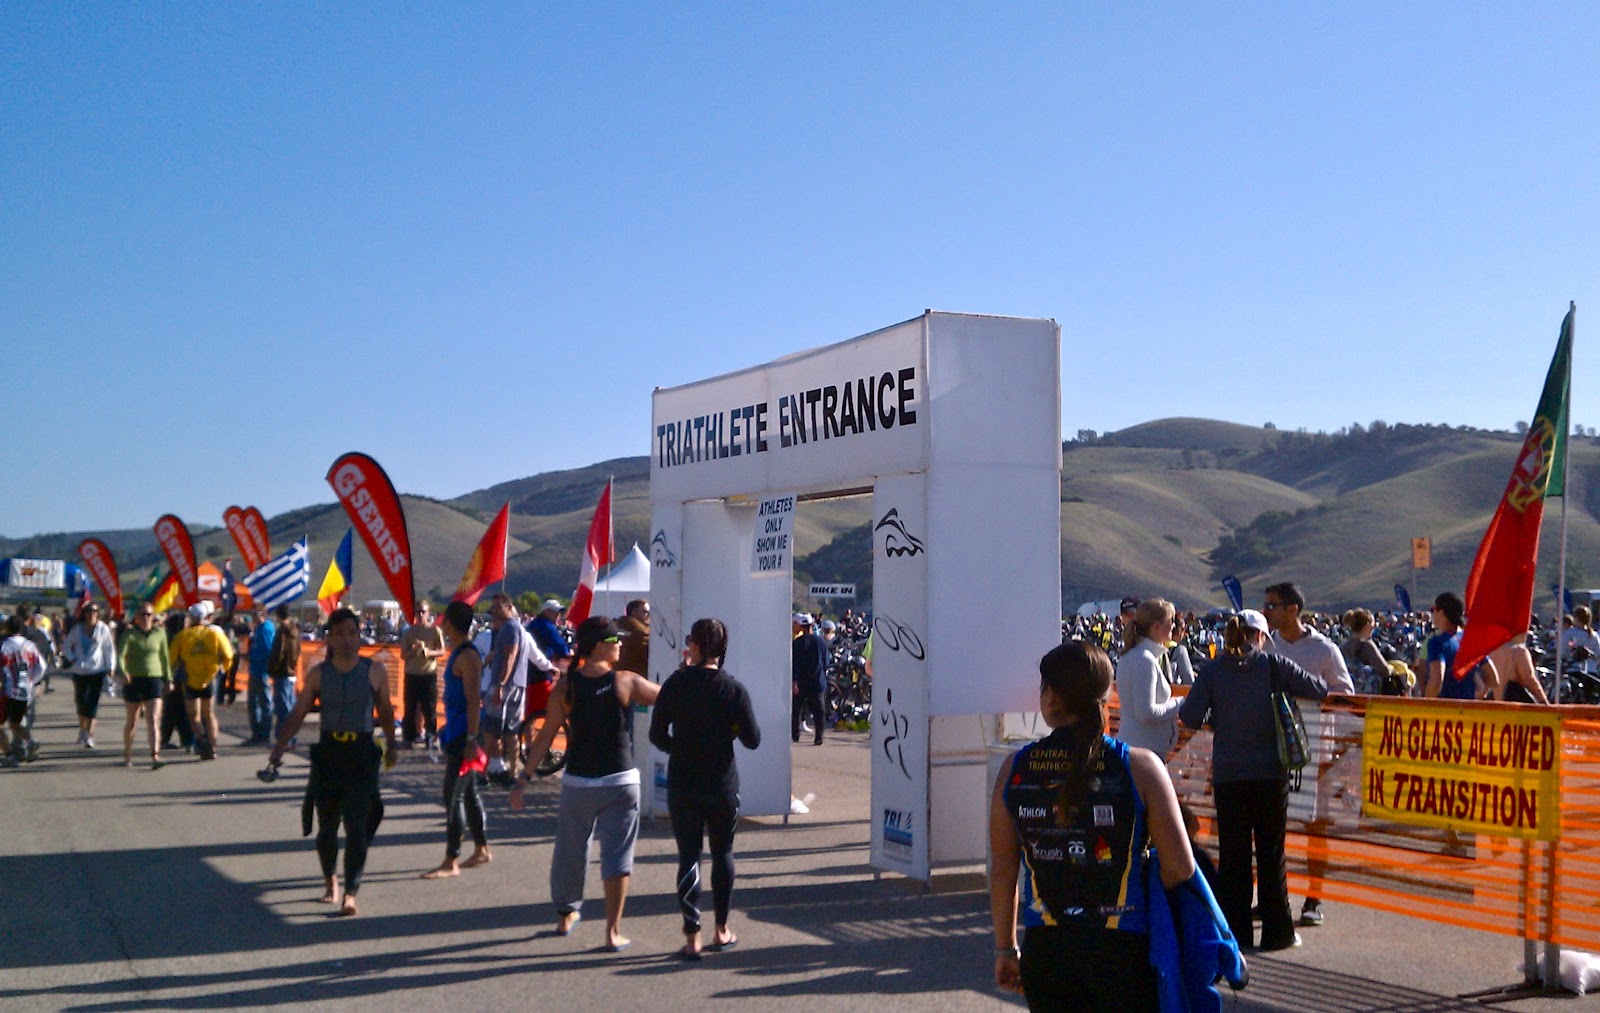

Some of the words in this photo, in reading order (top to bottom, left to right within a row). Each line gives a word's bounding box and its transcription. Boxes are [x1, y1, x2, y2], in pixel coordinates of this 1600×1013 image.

[657, 402, 768, 469] TRIATHLETE
[778, 366, 917, 449] ENTRANCE
[758, 496, 794, 517] ATHLETES
[764, 517, 784, 534] ONLY
[756, 536, 777, 553] SHOW
[776, 534, 788, 550] ME
[758, 554, 776, 571] YOUR
[811, 586, 838, 594] BIKE
[840, 586, 853, 594] IN
[1378, 714, 1403, 759] NO
[1407, 717, 1464, 764] GLASS
[1467, 721, 1555, 771] ALLOWED
[1029, 749, 1068, 758] CENTRAL
[1028, 760, 1072, 771] TRIATHLO
[1368, 767, 1385, 806] IN
[1392, 771, 1537, 829] TRANSITION
[883, 808, 902, 829] TRI
